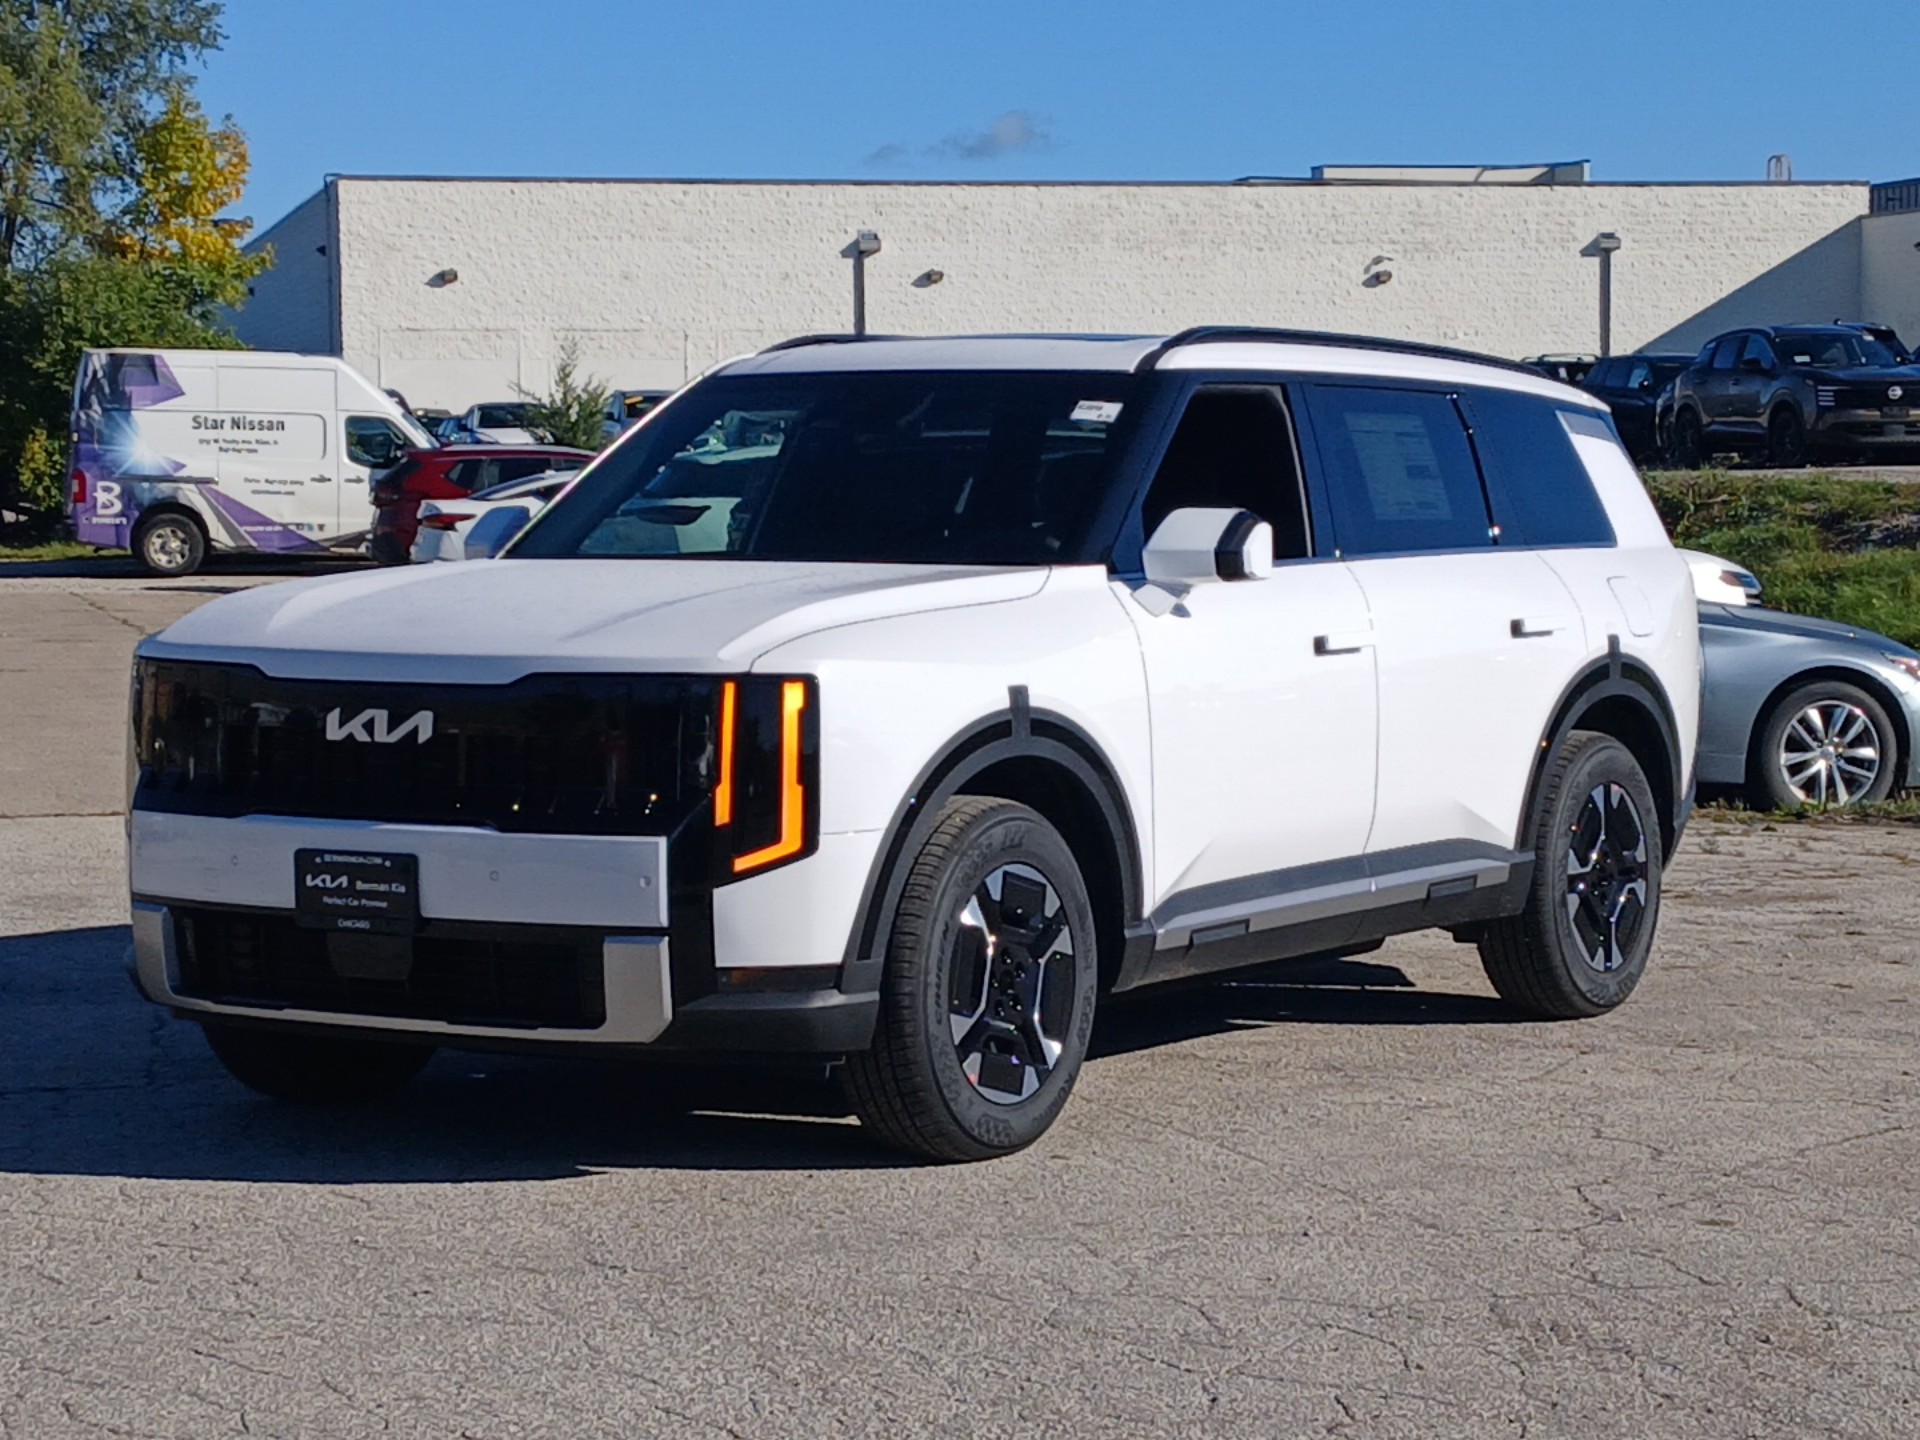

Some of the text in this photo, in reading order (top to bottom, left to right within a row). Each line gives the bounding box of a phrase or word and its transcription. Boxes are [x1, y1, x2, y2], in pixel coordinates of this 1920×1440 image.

[191, 415, 285, 431] Star Nissan
[326, 708, 433, 744] KIA
[305, 873, 348, 888] KIA
